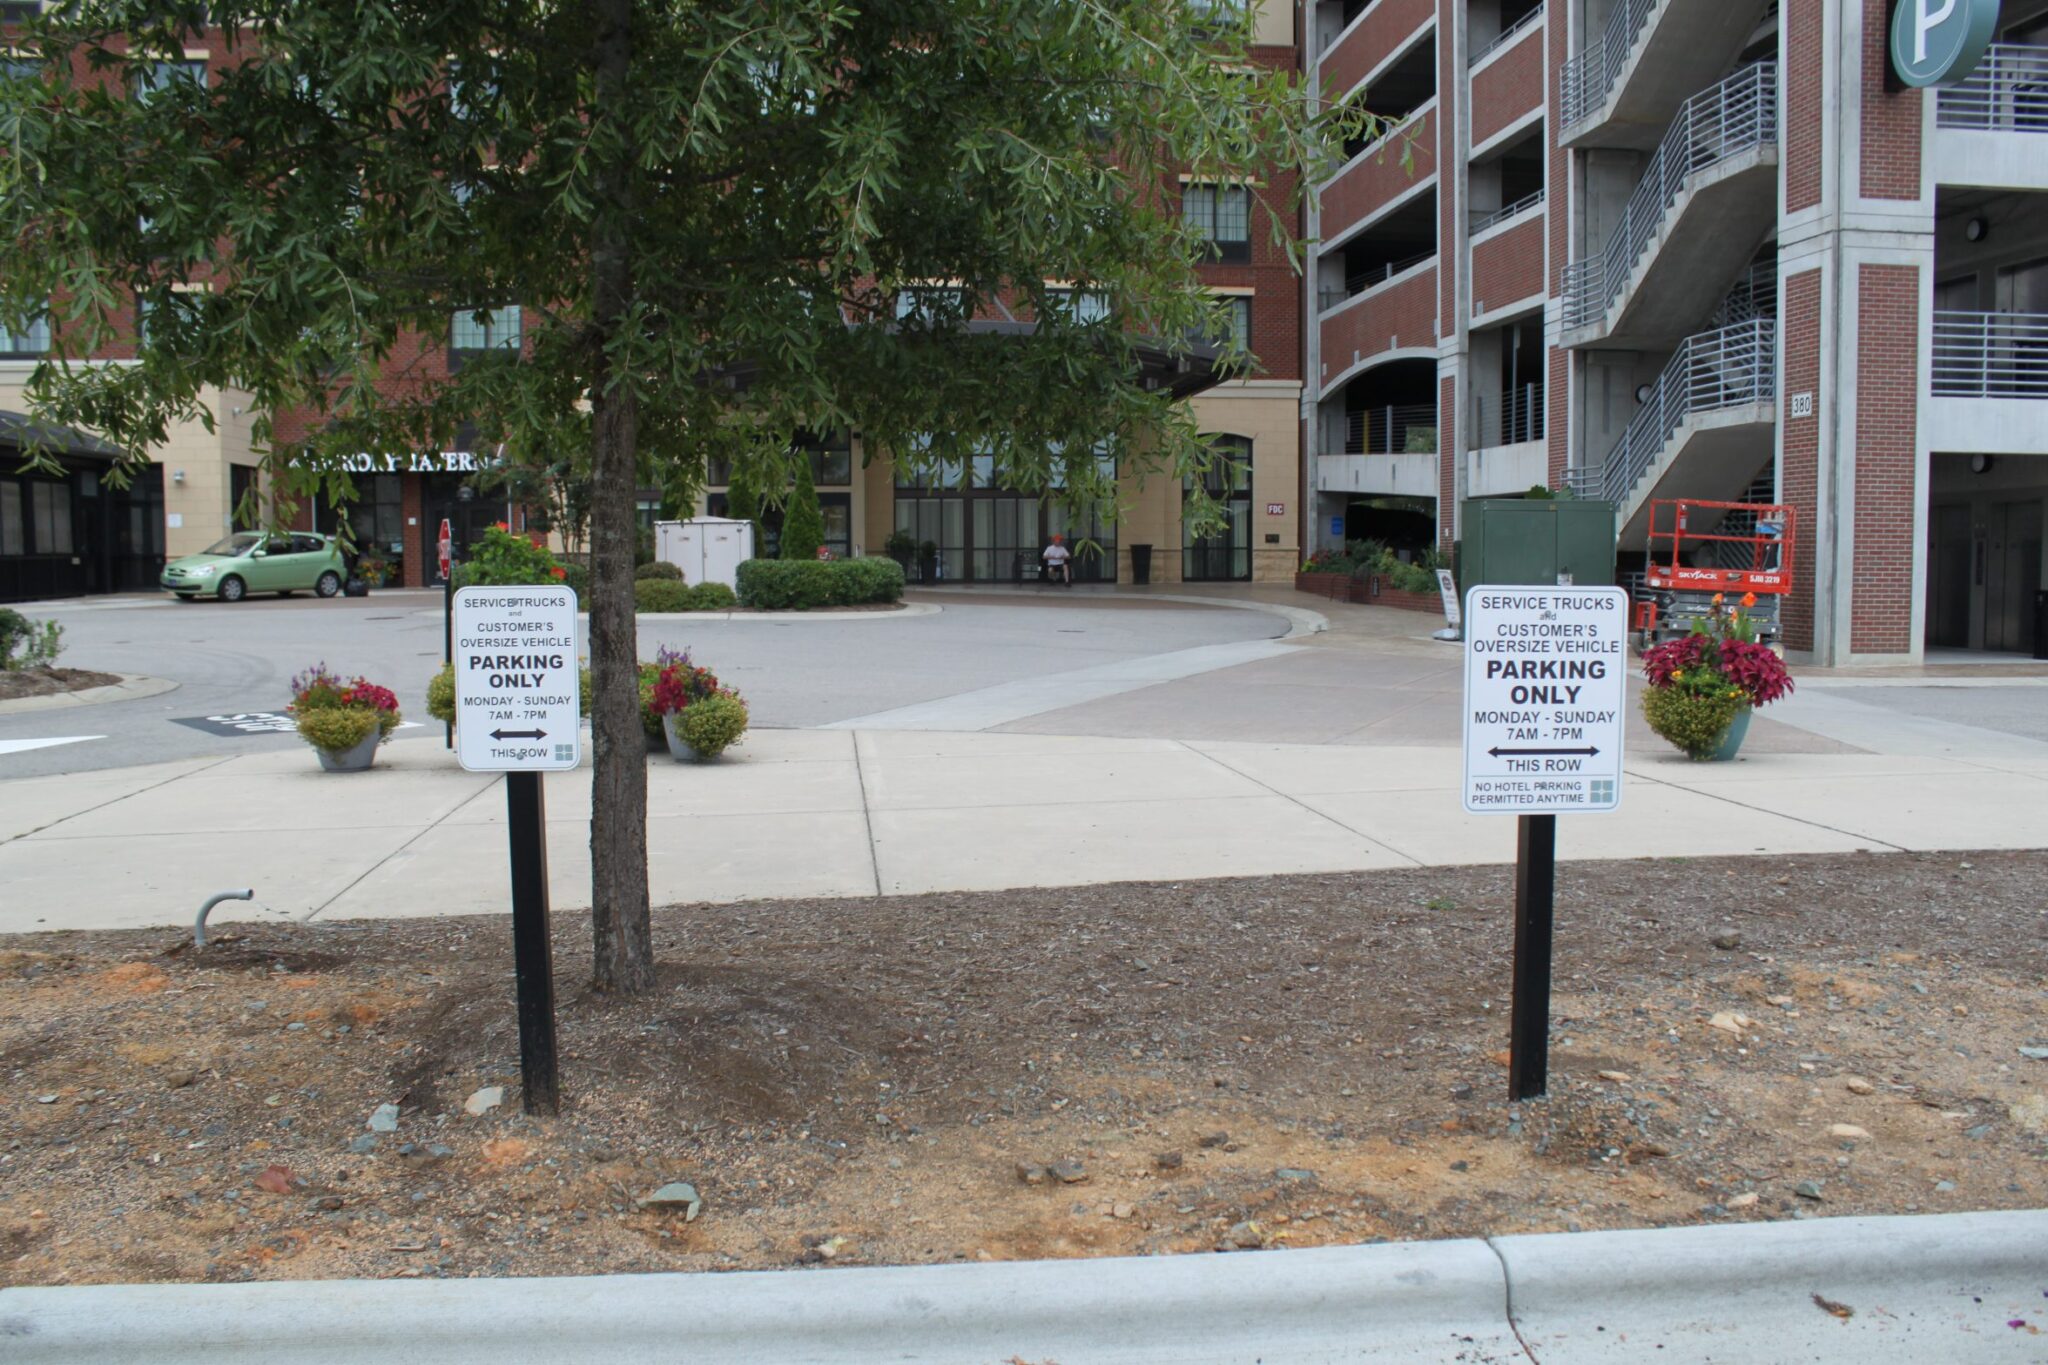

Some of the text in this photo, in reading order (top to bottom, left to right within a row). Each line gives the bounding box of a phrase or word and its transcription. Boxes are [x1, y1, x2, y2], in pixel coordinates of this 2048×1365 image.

[1794, 397, 1810, 414] 380
[1268, 505, 1283, 514] FDC
[1678, 570, 1718, 580] SKYJACK
[464, 597, 566, 608] SERVICE TRUCKS
[1481, 596, 1615, 610] SERVICE TRUCKS
[1539, 612, 1557, 621] and
[477, 622, 554, 632] CUSTOMER'S
[1497, 624, 1598, 637] CUSTOMER'S
[460, 637, 571, 647] OVERSIZE VEHICLE
[1474, 640, 1620, 653] OVERSIZE VEHICLE
[470, 655, 563, 670] PARKING
[1487, 660, 1606, 680] PARKING
[489, 674, 545, 688] ONLY
[464, 696, 514, 706] MONDAY
[524, 696, 571, 705] SUNDAY
[1511, 685, 1582, 705] ONLY
[489, 711, 513, 720] 7AM
[523, 710, 547, 719] 7PM
[1474, 711, 1540, 724] MONDAY
[1554, 711, 1615, 723] SUNDAY
[1507, 728, 1538, 740] 7AM
[1552, 727, 1583, 740] 7PM
[490, 748, 548, 758] THIS ROW
[1506, 759, 1582, 772] THIS ROW
[1475, 781, 1582, 792] NO HOTEL PARKING
[1472, 793, 1584, 804] PERMITTED ANYTIME
